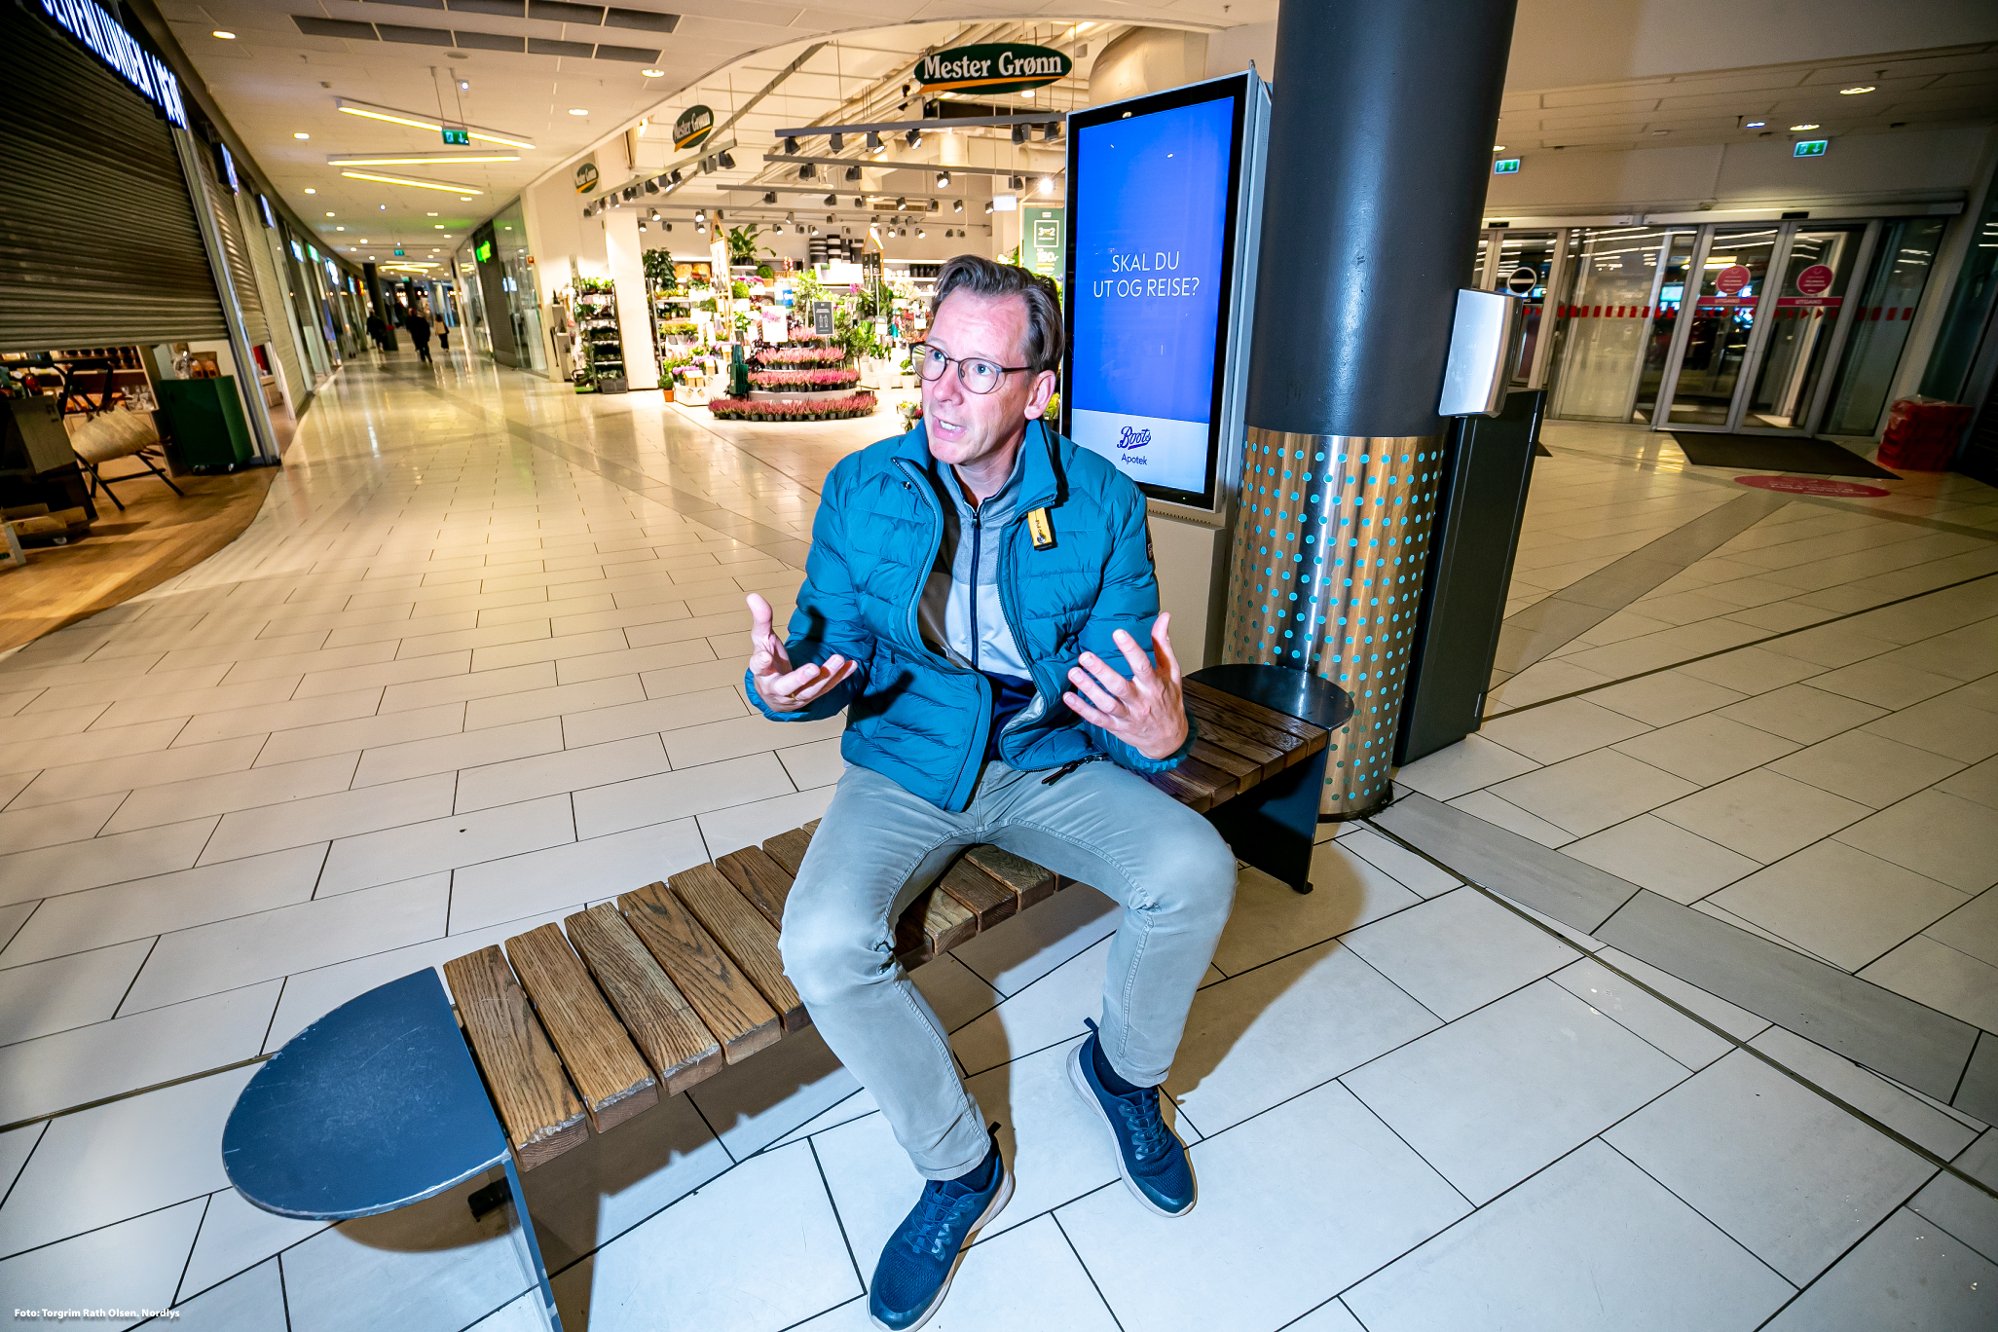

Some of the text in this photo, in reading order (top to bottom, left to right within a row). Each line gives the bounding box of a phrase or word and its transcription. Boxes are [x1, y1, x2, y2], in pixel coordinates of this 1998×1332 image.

[923, 51, 1062, 80] Mester Grønn
[1111, 250, 1180, 273] SKAL DU
[1093, 277, 1200, 298] UT OG REISE?
[1117, 425, 1151, 450] Boots
[1121, 452, 1148, 466] Apotek
